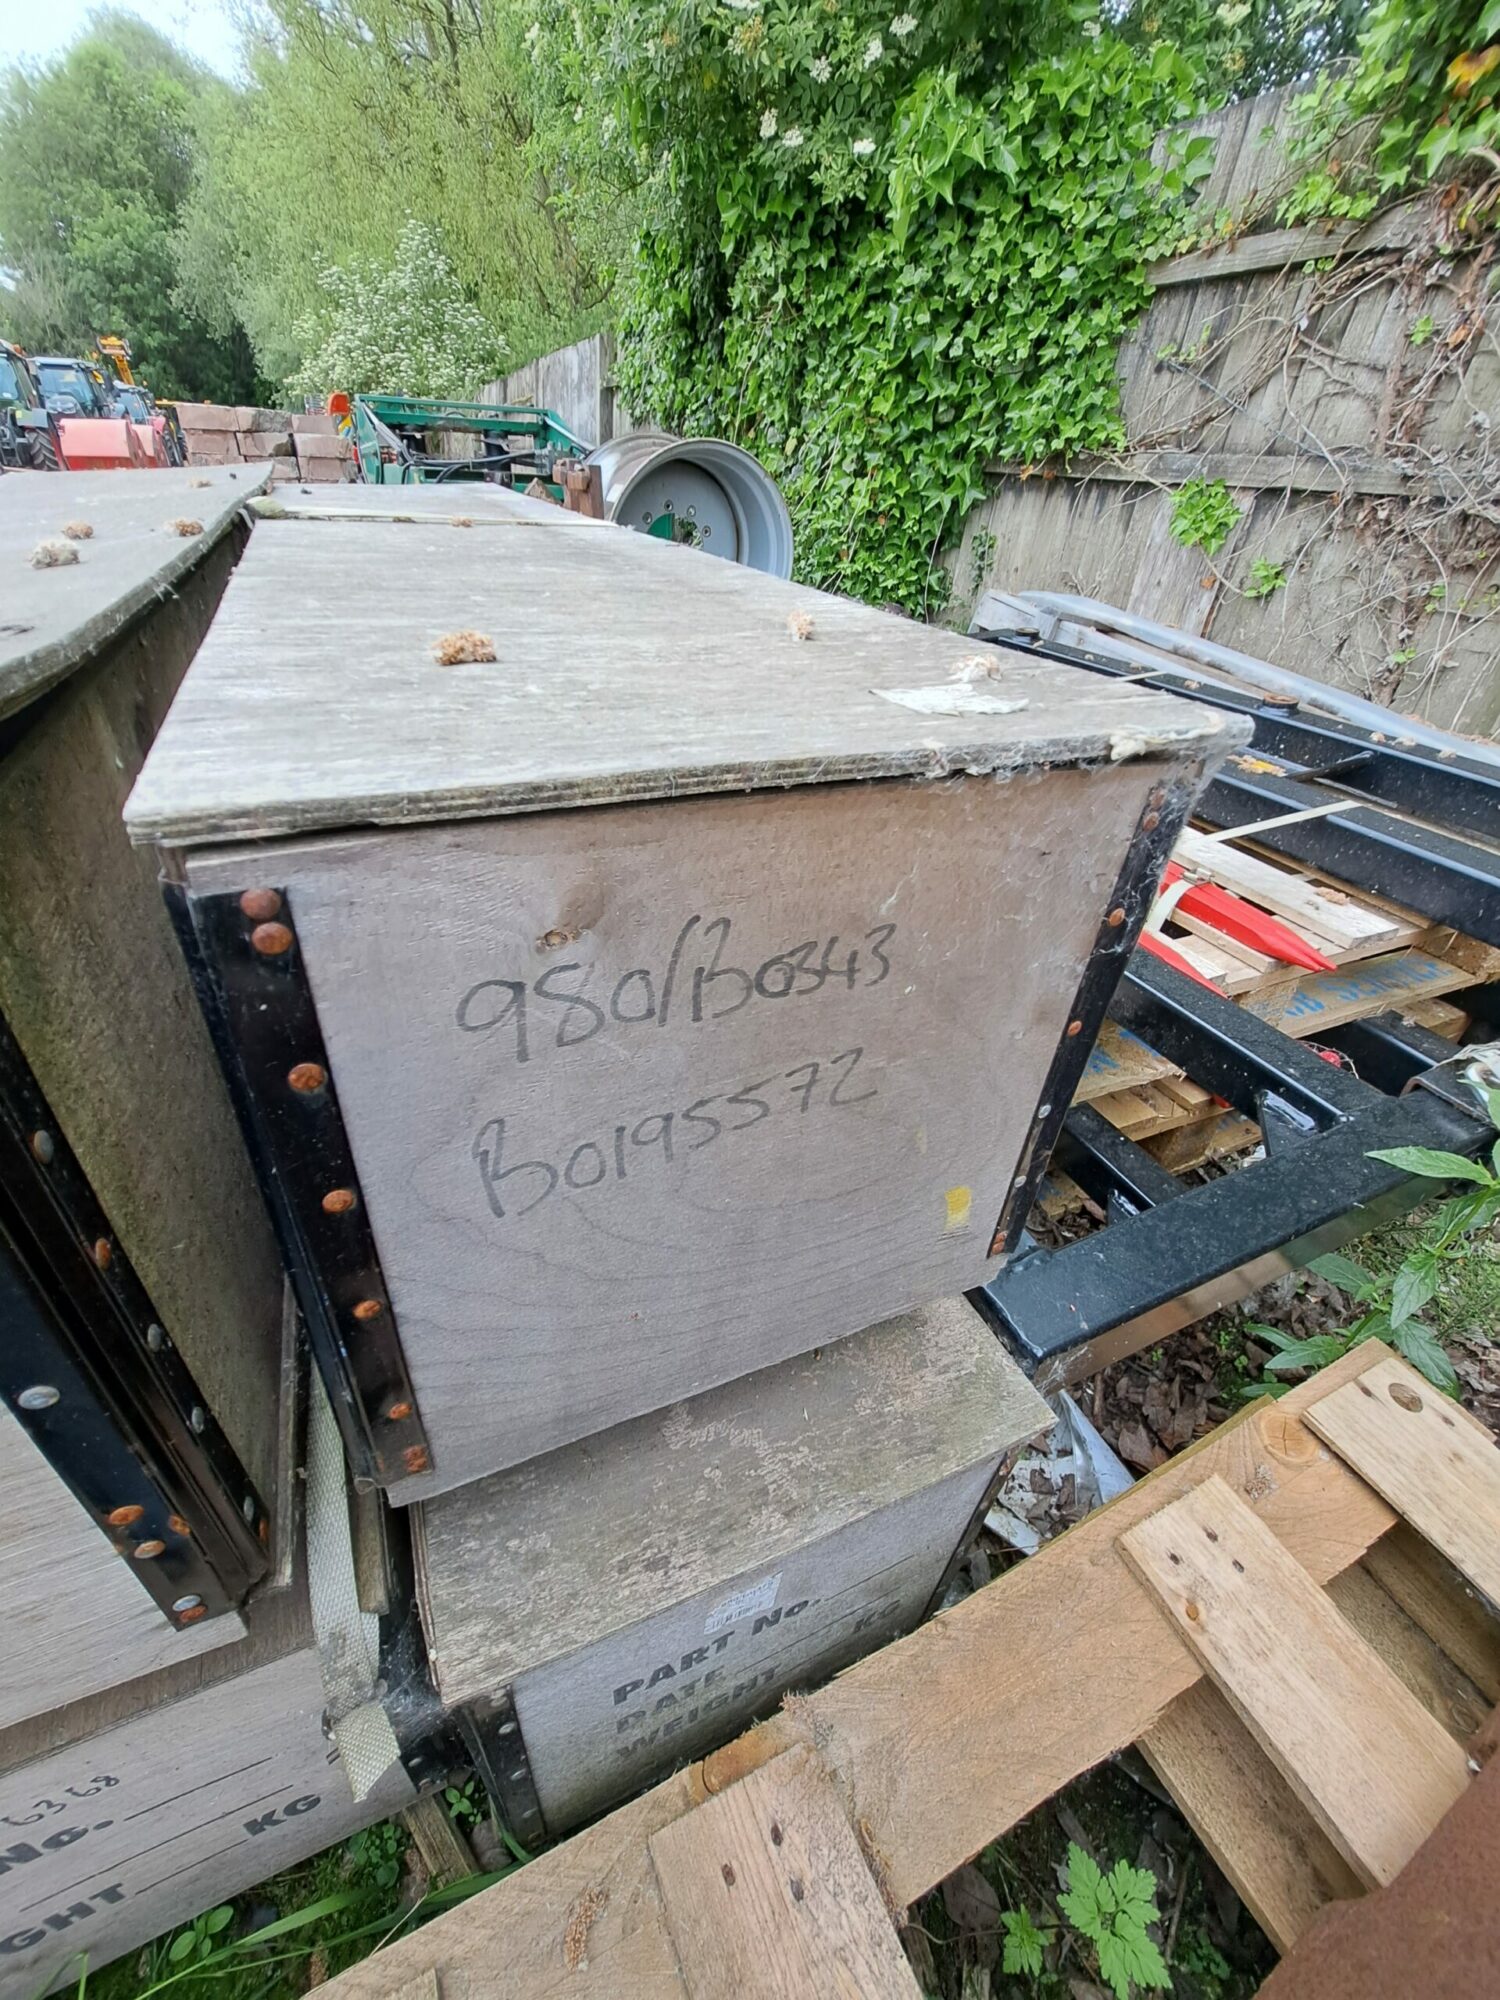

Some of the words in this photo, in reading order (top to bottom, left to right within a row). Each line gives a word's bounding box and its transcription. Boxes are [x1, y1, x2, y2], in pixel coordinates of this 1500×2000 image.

[472, 1047, 878, 1218] B0195572
[613, 1630, 735, 1706] PART
[616, 1665, 726, 1734] DATE
[616, 1663, 782, 1757] WEIGHT
[242, 1793, 322, 1837] KG
